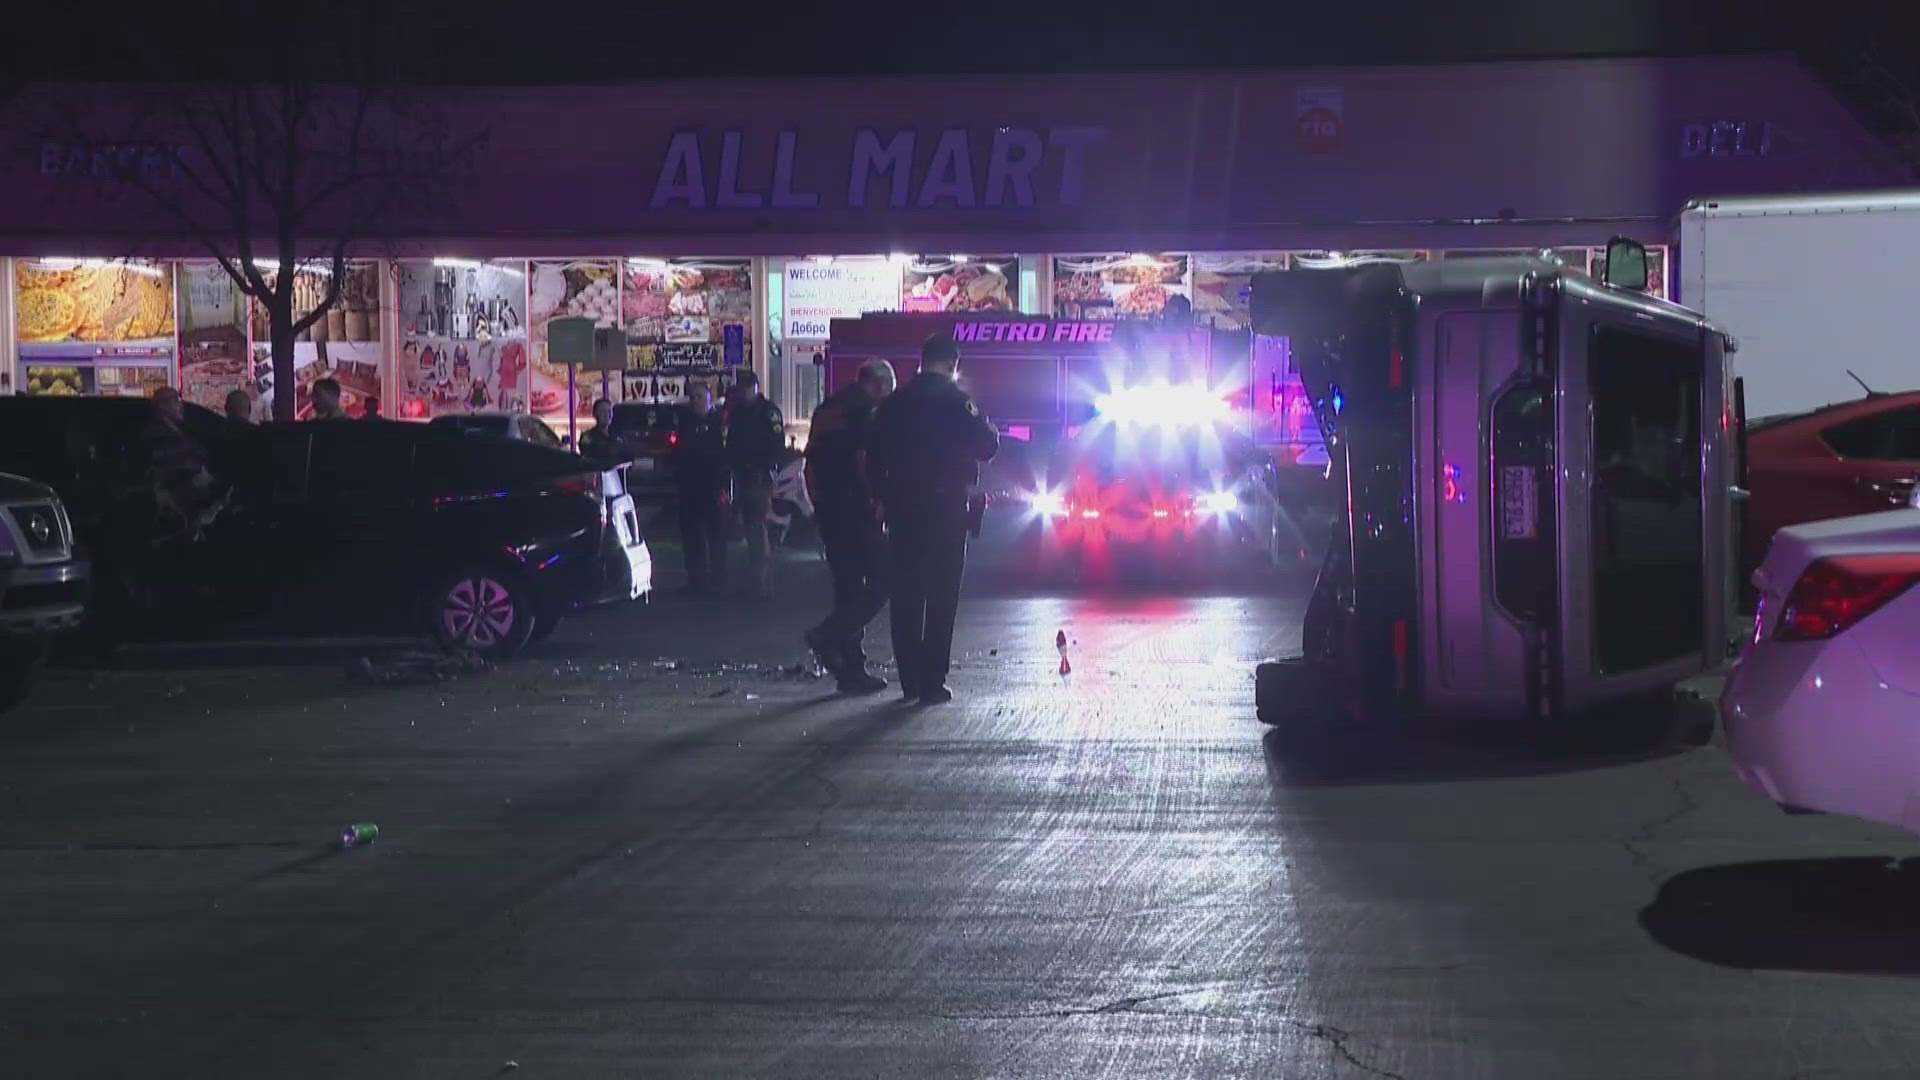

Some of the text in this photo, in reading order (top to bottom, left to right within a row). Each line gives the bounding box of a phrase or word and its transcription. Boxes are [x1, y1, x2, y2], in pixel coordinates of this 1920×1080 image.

[1682, 121, 1772, 160] DELI
[648, 125, 1109, 208] ALL MART
[790, 268, 842, 280] WELCOME
[791, 321, 826, 336] Добро
[953, 322, 1114, 342] METRO FIRE
